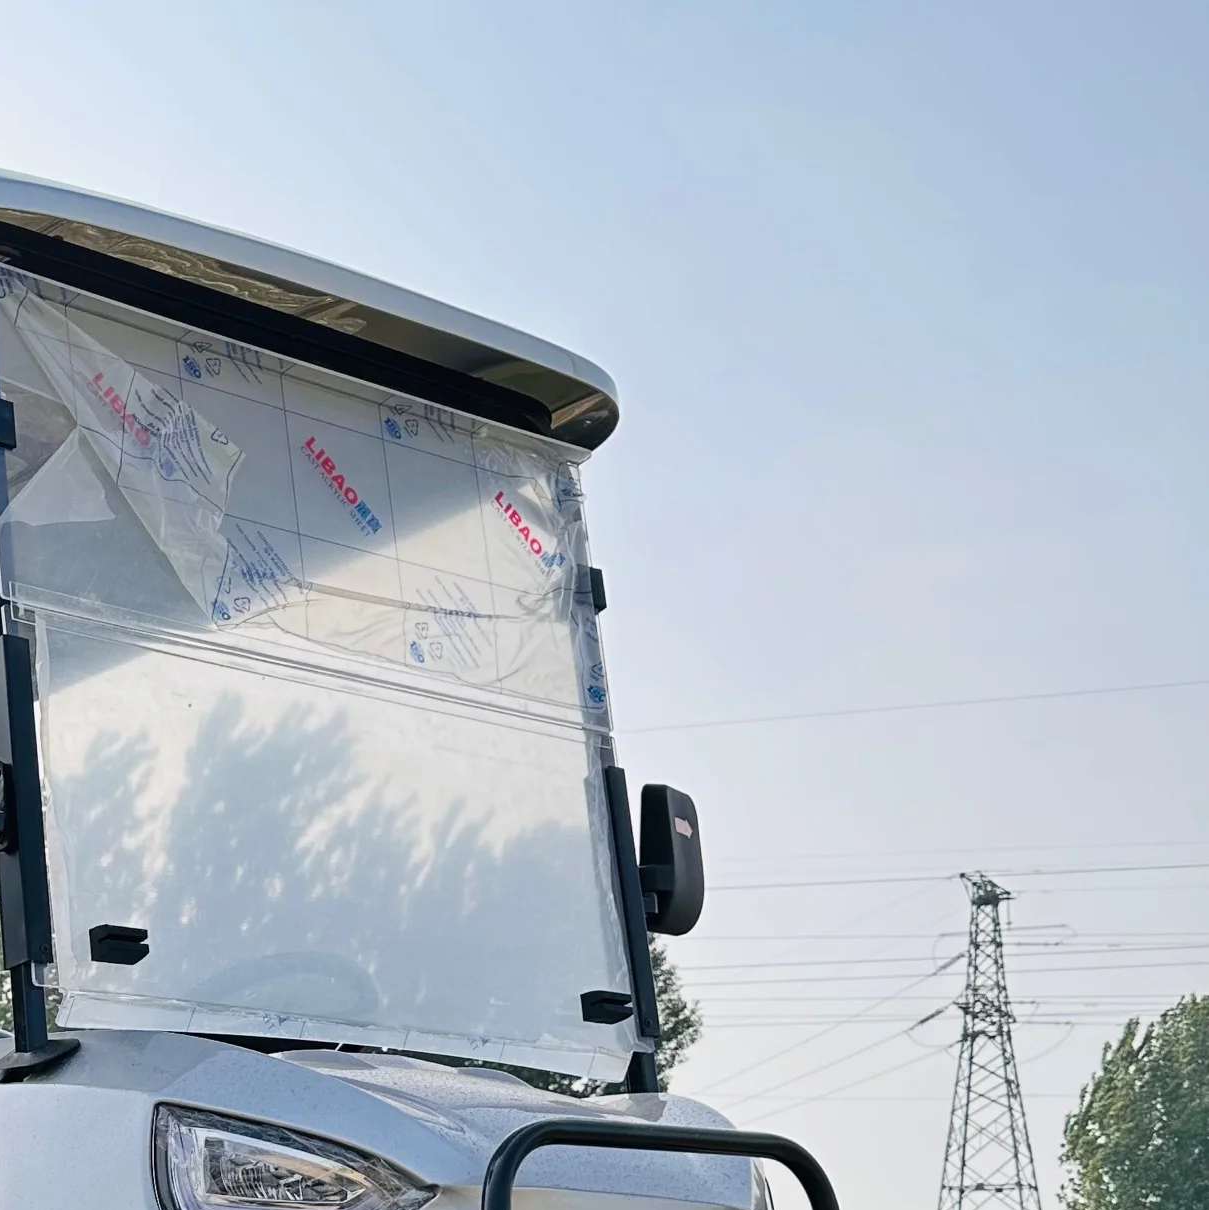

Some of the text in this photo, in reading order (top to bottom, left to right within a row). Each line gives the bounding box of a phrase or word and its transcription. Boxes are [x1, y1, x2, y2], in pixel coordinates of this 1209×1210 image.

[92, 371, 151, 448] LIBAO
[300, 445, 371, 537] CAST ACRYLIC SHEET
[305, 435, 358, 504] LIBAO
[494, 490, 542, 554] LIBAO
